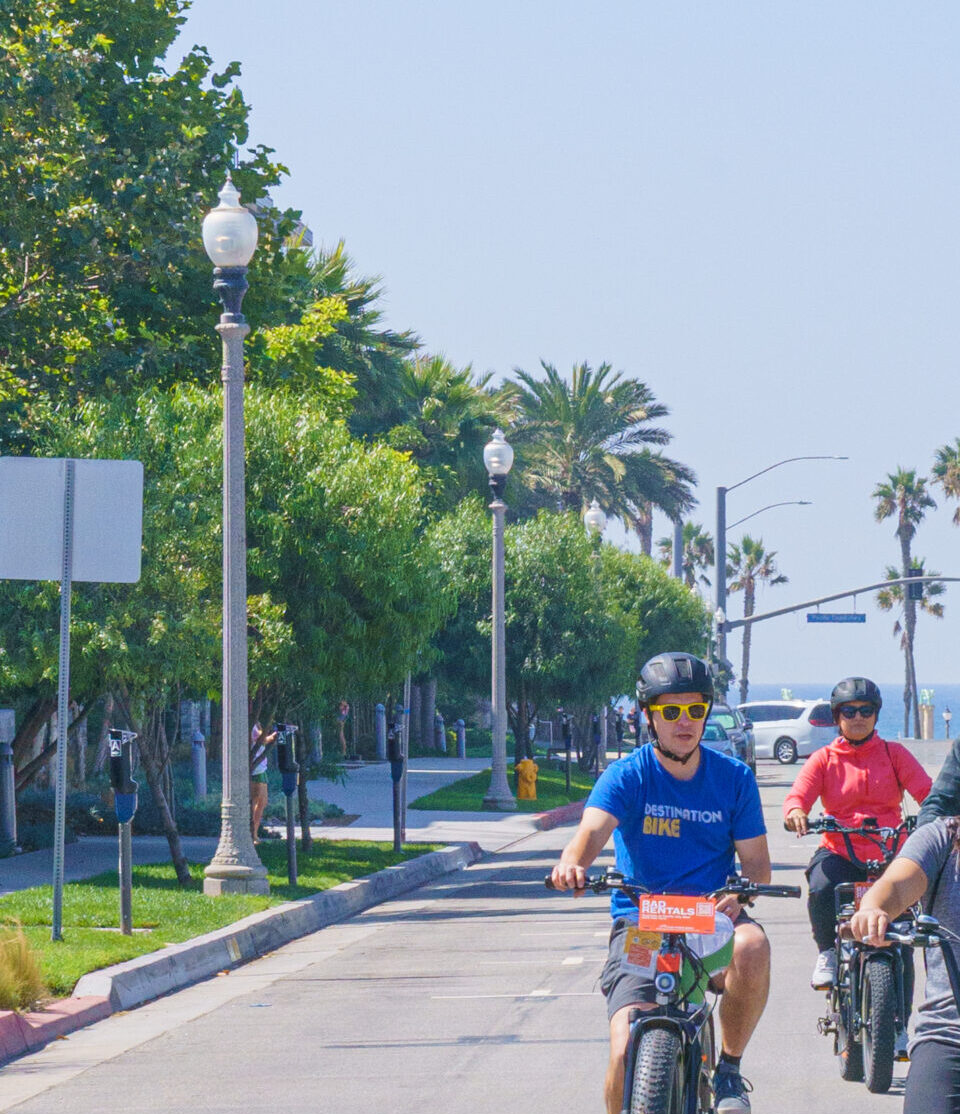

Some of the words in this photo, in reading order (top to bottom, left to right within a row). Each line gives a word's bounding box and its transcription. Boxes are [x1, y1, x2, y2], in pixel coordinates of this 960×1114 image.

[644, 802, 723, 824] DESTINATION
[642, 816, 681, 838] BIKE
[642, 905, 696, 916] RENTALS
